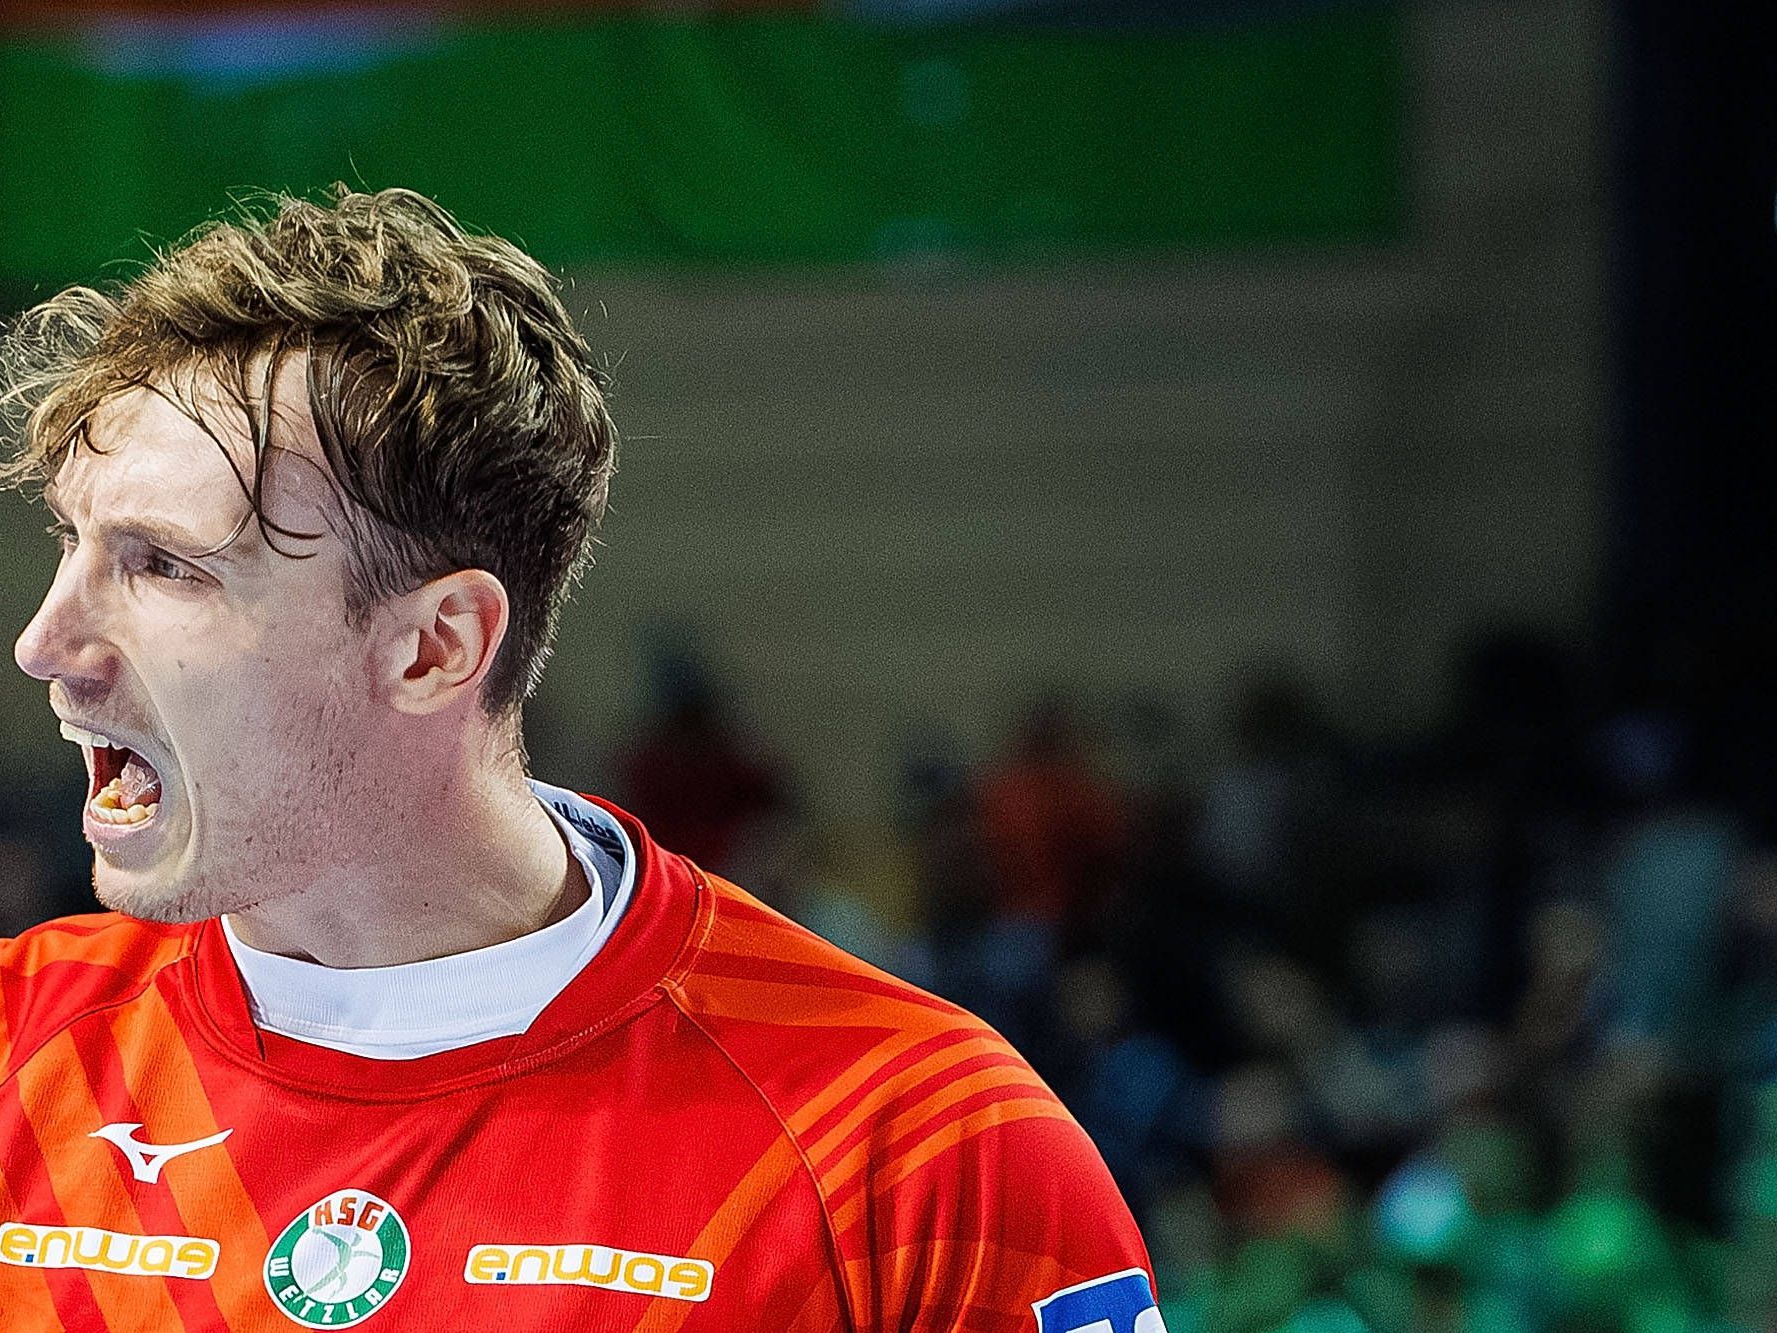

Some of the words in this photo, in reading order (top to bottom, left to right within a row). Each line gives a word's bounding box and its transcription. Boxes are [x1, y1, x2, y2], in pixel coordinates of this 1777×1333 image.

[315, 1197, 385, 1232] HSG
[0, 1227, 215, 1276] enwag
[471, 1248, 709, 1297] enwag
[269, 1256, 401, 1324] WETZLAR
